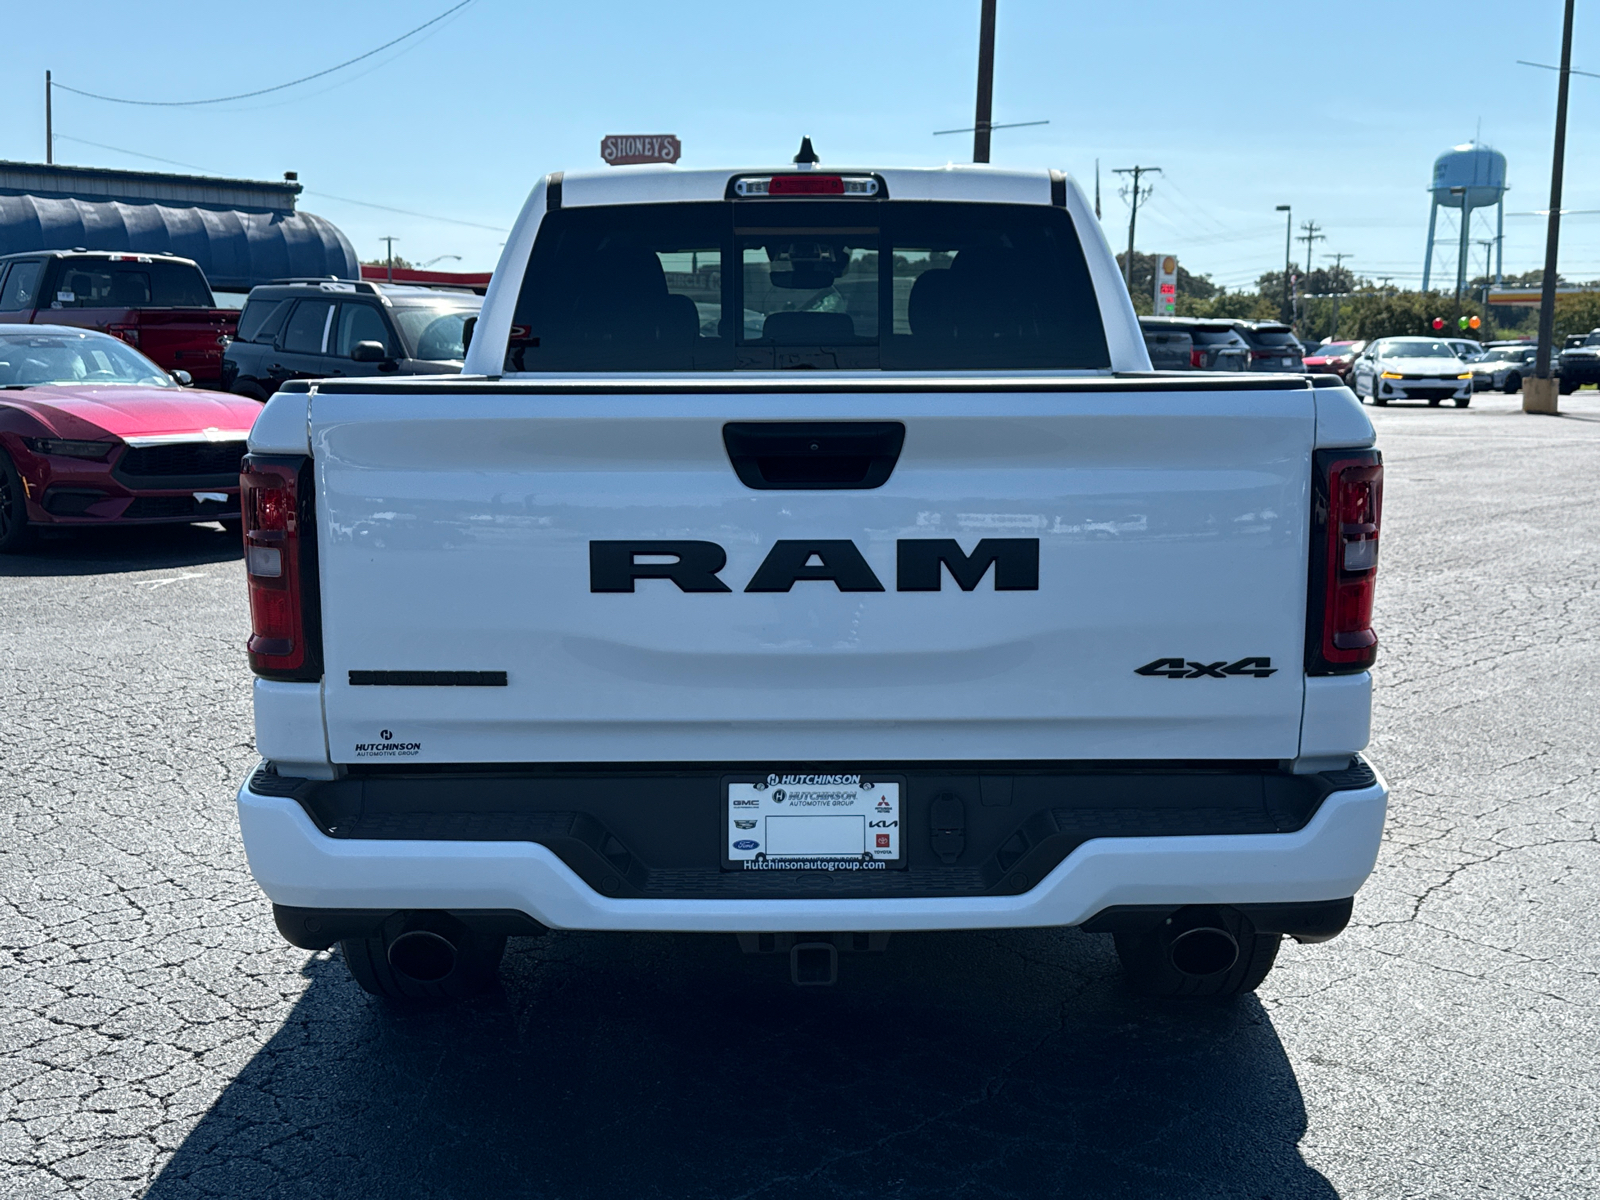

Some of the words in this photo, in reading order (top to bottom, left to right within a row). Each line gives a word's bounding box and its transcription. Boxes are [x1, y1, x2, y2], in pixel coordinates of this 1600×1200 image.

[604, 137, 675, 160] SHONEY'S
[666, 274, 707, 288] CIRCLE
[589, 538, 1040, 593] RAM
[1133, 657, 1279, 679] 4x4
[355, 743, 421, 751] HUTCHINSON
[781, 774, 861, 785] HUTCHINSON
[788, 791, 858, 801] HUTCHINSON
[868, 820, 898, 828] KIA
[743, 859, 886, 871] Hutchinsonautogroup.com
